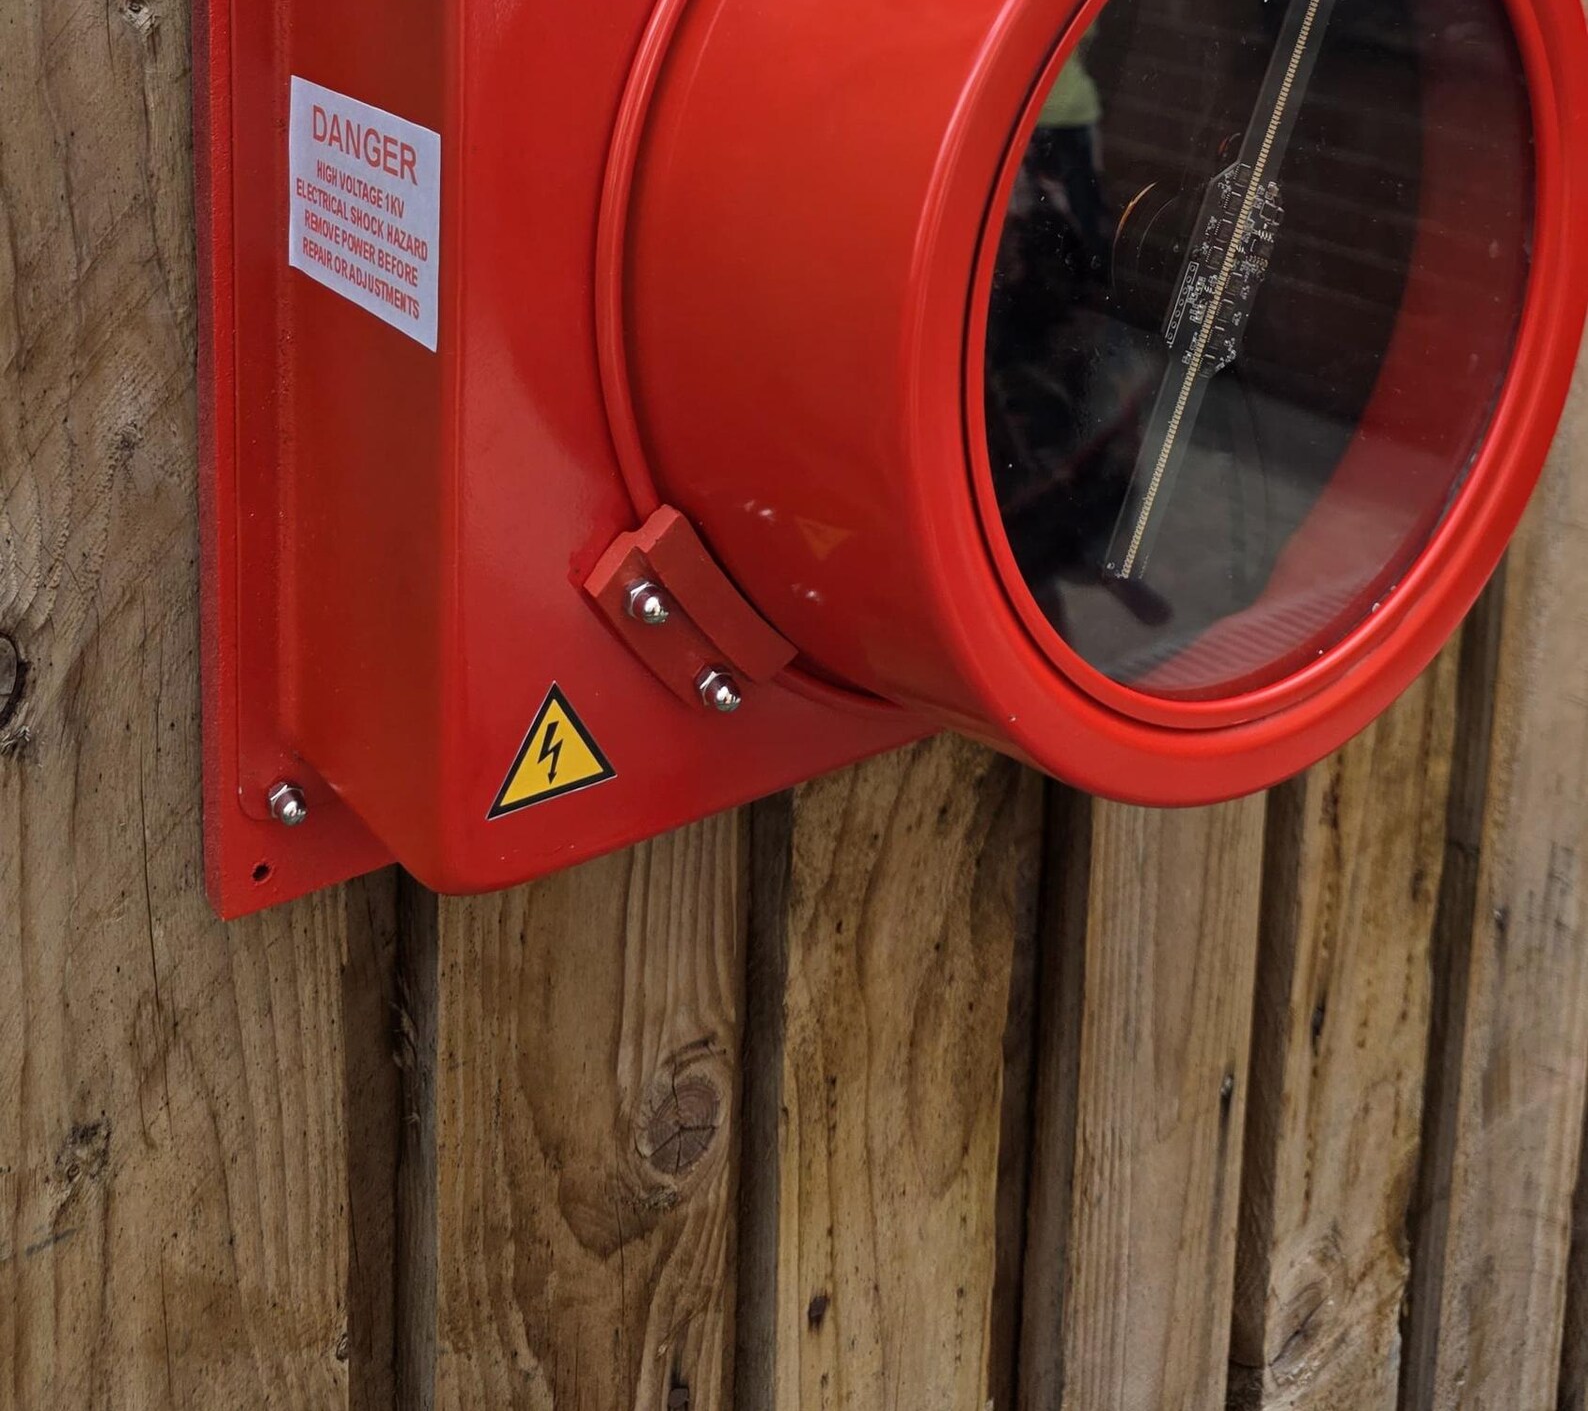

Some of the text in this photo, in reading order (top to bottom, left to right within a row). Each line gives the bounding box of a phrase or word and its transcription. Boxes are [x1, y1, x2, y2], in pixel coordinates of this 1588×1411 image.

[312, 104, 419, 186] DANGER
[296, 178, 428, 263] ELECTRICAL SHOCK HAZARD
[316, 159, 405, 219] HIGH VOLTAGE 1KV
[302, 236, 420, 322] REPAIR OR ADJUSTMENTS
[304, 209, 419, 288] REMOVE POWER BEFORE
